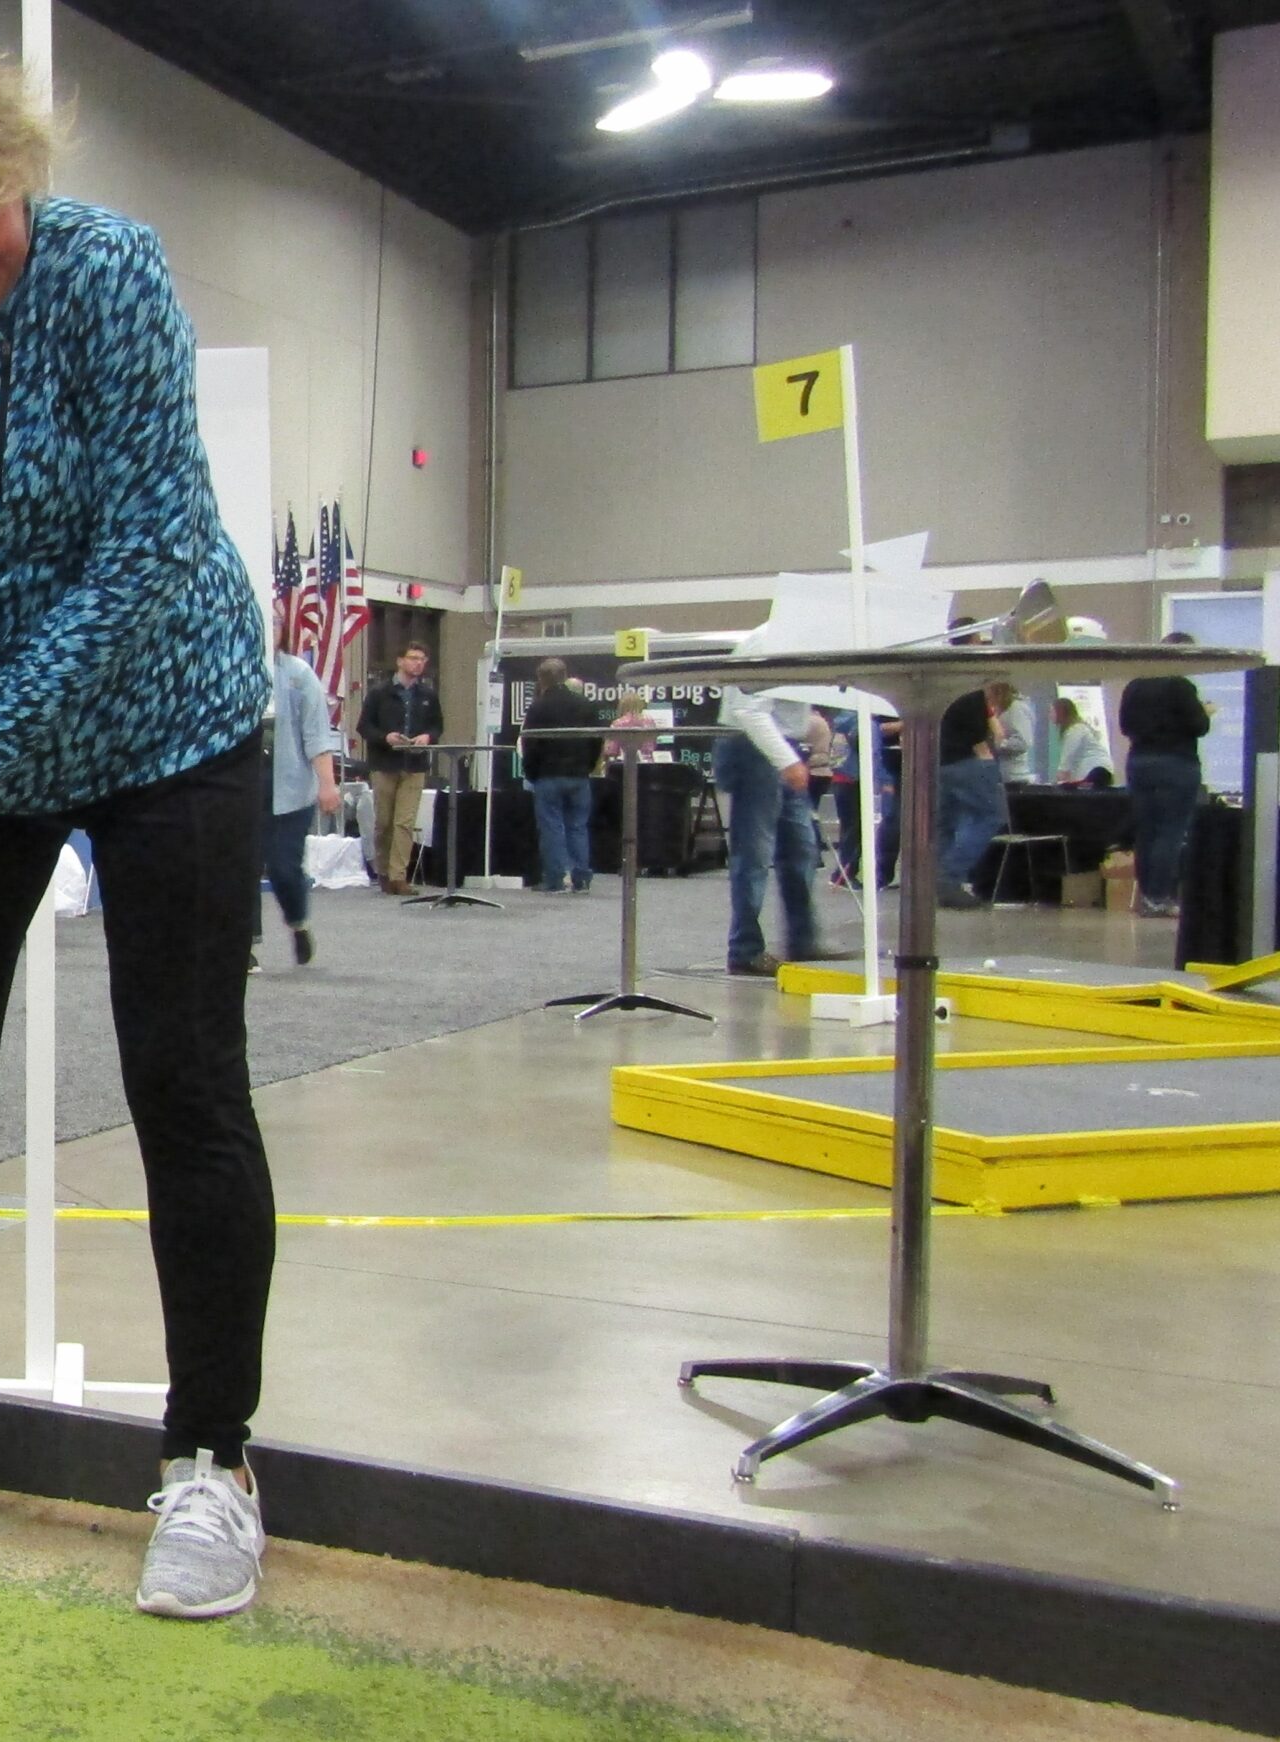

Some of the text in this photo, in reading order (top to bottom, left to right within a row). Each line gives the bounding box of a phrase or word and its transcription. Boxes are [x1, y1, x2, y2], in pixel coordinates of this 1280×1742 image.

[786, 370, 820, 416] 7
[508, 576, 515, 598] 6
[626, 635, 637, 650] 3
[680, 749, 700, 763] Be
